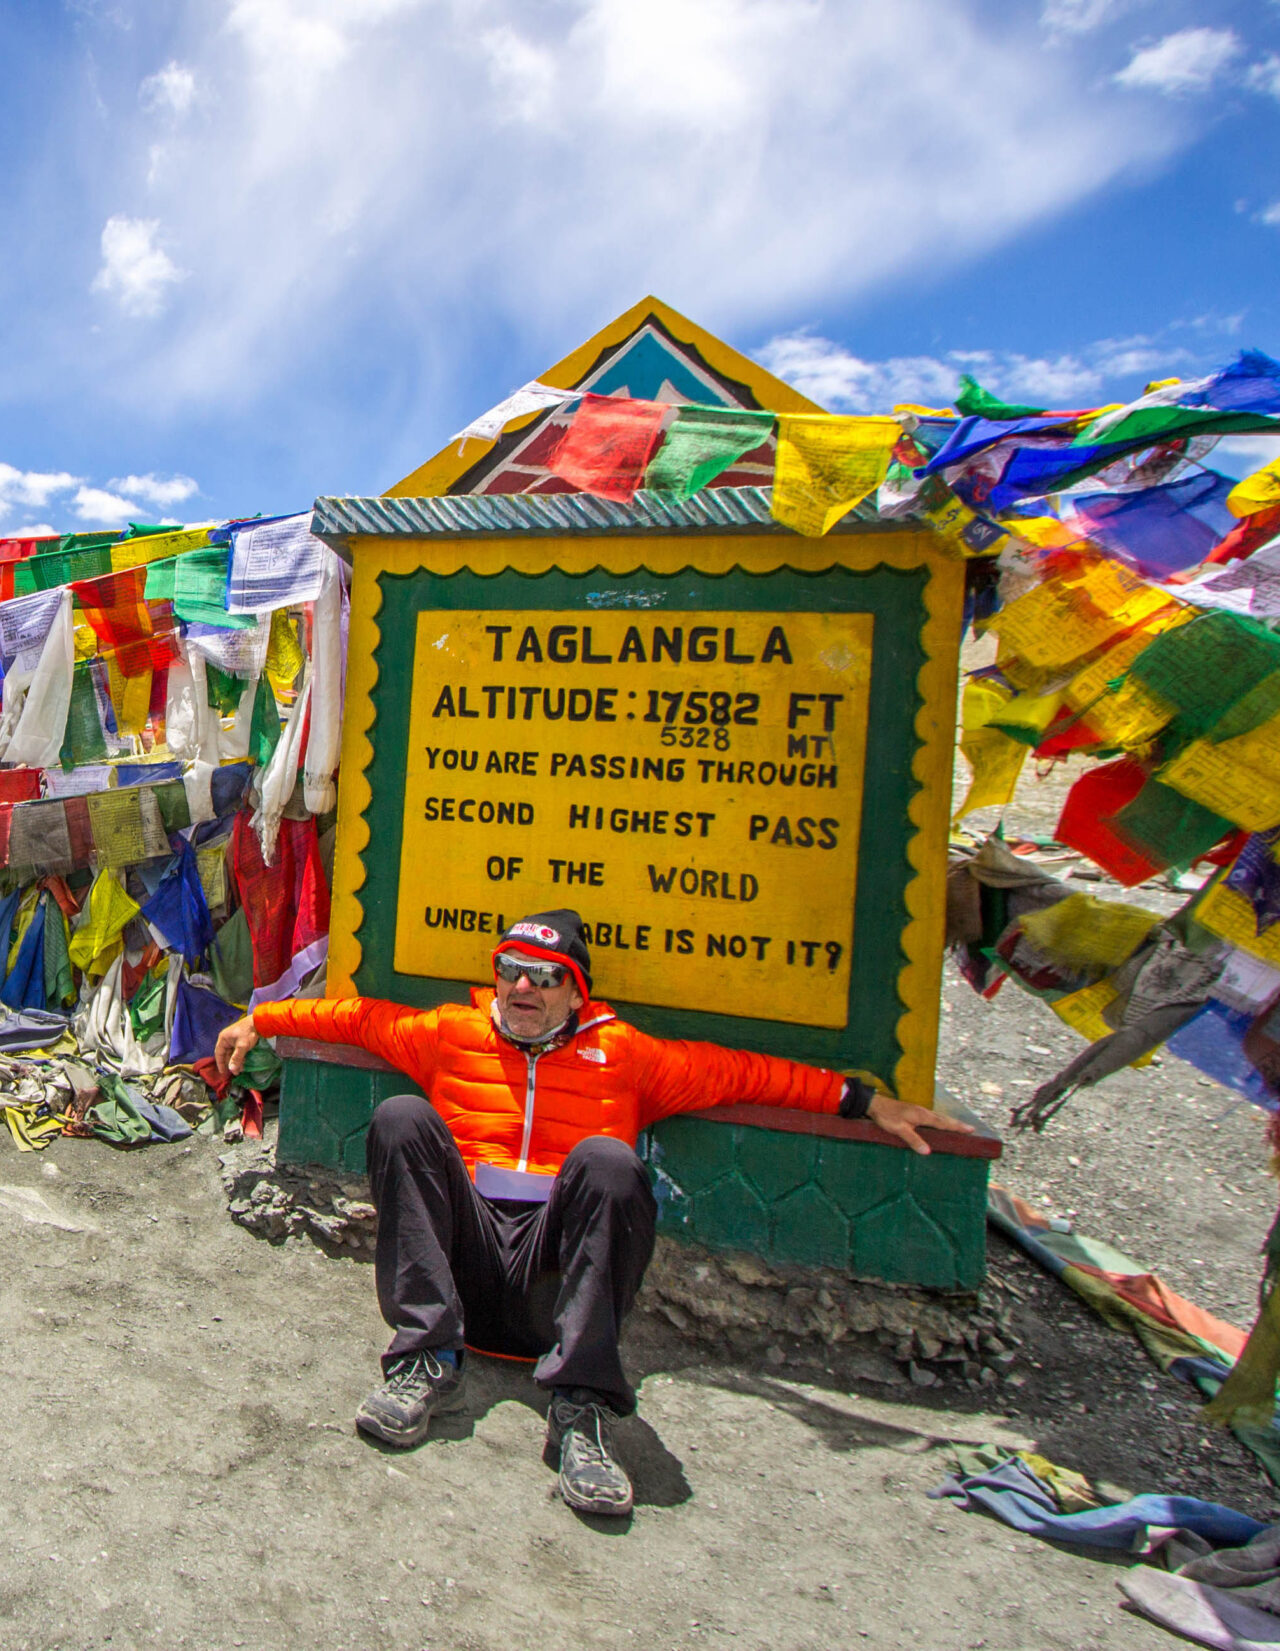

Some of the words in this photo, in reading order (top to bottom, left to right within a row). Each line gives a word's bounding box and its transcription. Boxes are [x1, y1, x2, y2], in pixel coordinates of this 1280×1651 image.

[485, 625, 793, 664] TAGLANGLA
[788, 692, 844, 732] FT
[660, 726, 730, 752] 5328
[787, 734, 829, 759] MT
[425, 747, 478, 771] YOU
[485, 750, 539, 776] ARE
[550, 753, 686, 782] PASSING
[698, 760, 837, 788] THROUGH
[424, 797, 534, 825] SECOND
[569, 804, 715, 837] HIGHEST
[749, 814, 840, 850] PASS
[486, 856, 523, 881] OF
[548, 859, 604, 886] THE
[648, 864, 759, 902] WORLD
[665, 929, 694, 954] IS
[706, 934, 771, 961] NOT
[786, 940, 842, 975] IT?
